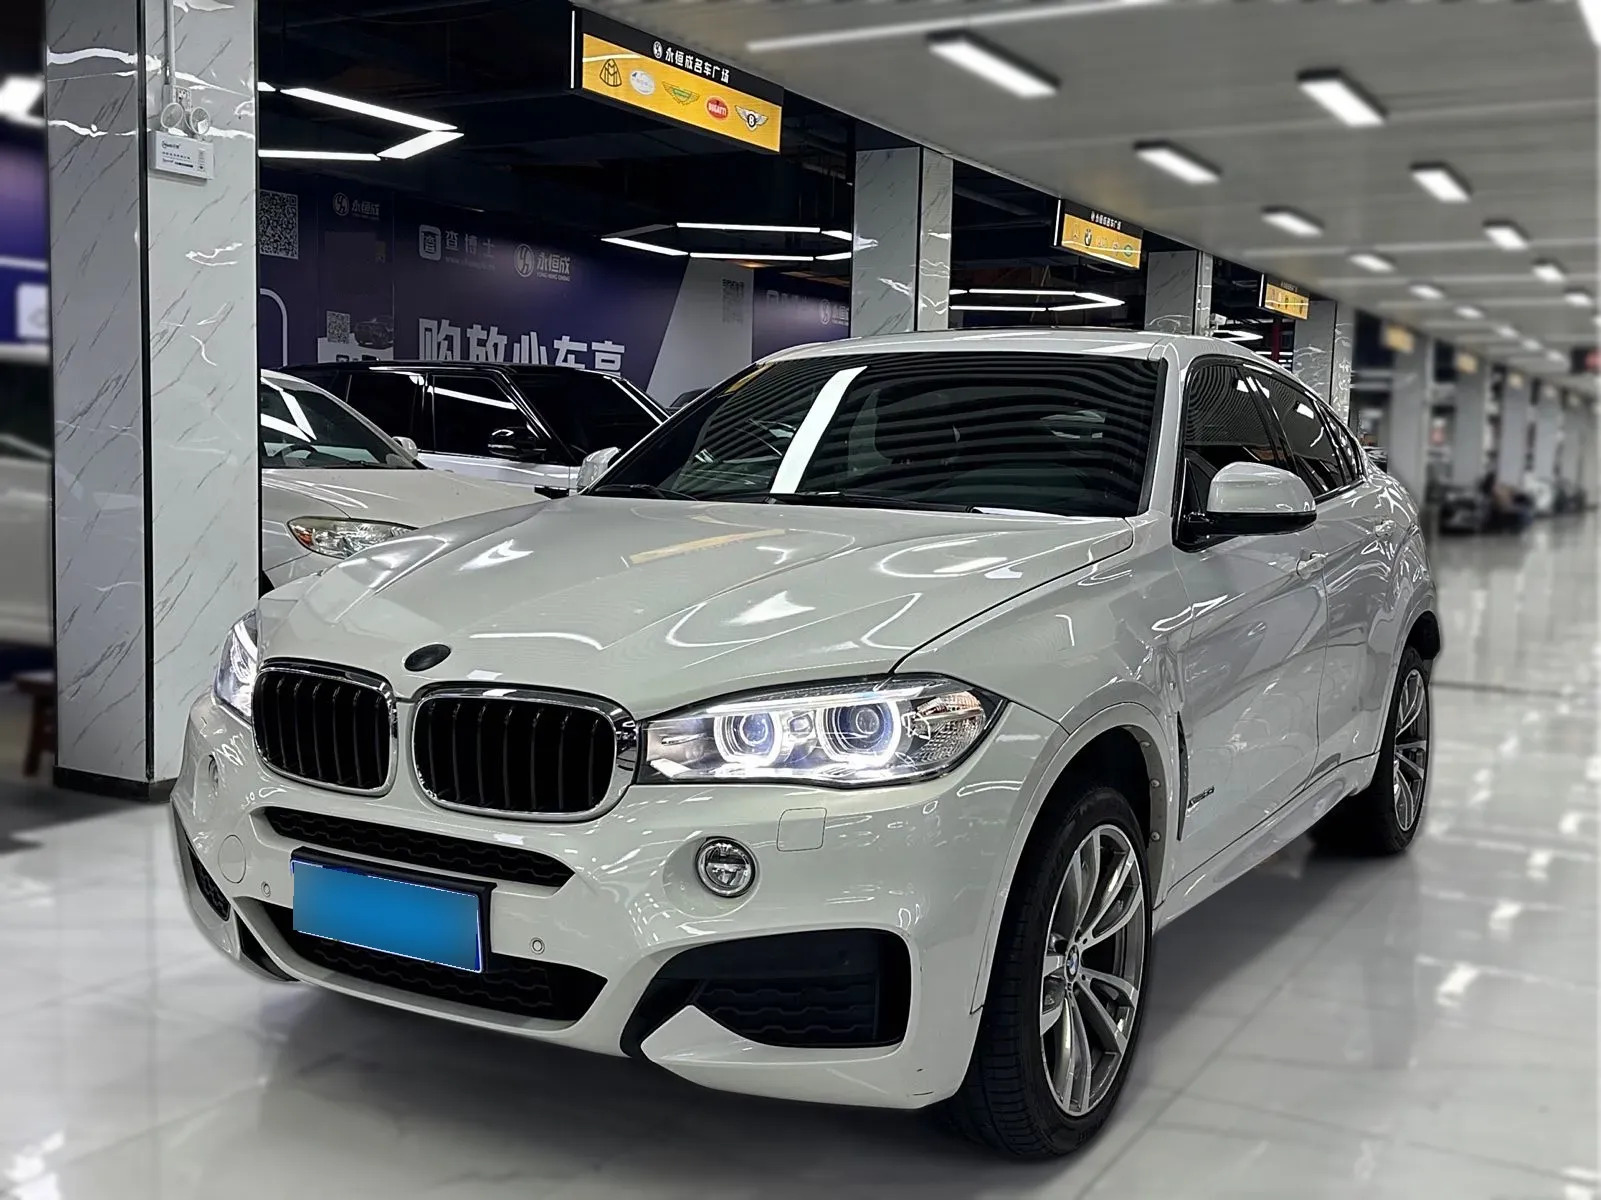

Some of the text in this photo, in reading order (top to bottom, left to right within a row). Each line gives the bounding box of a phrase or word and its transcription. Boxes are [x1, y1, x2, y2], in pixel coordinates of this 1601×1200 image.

[665, 47, 730, 84] 永恒成名车广场
[536, 251, 571, 275] 永恒成
